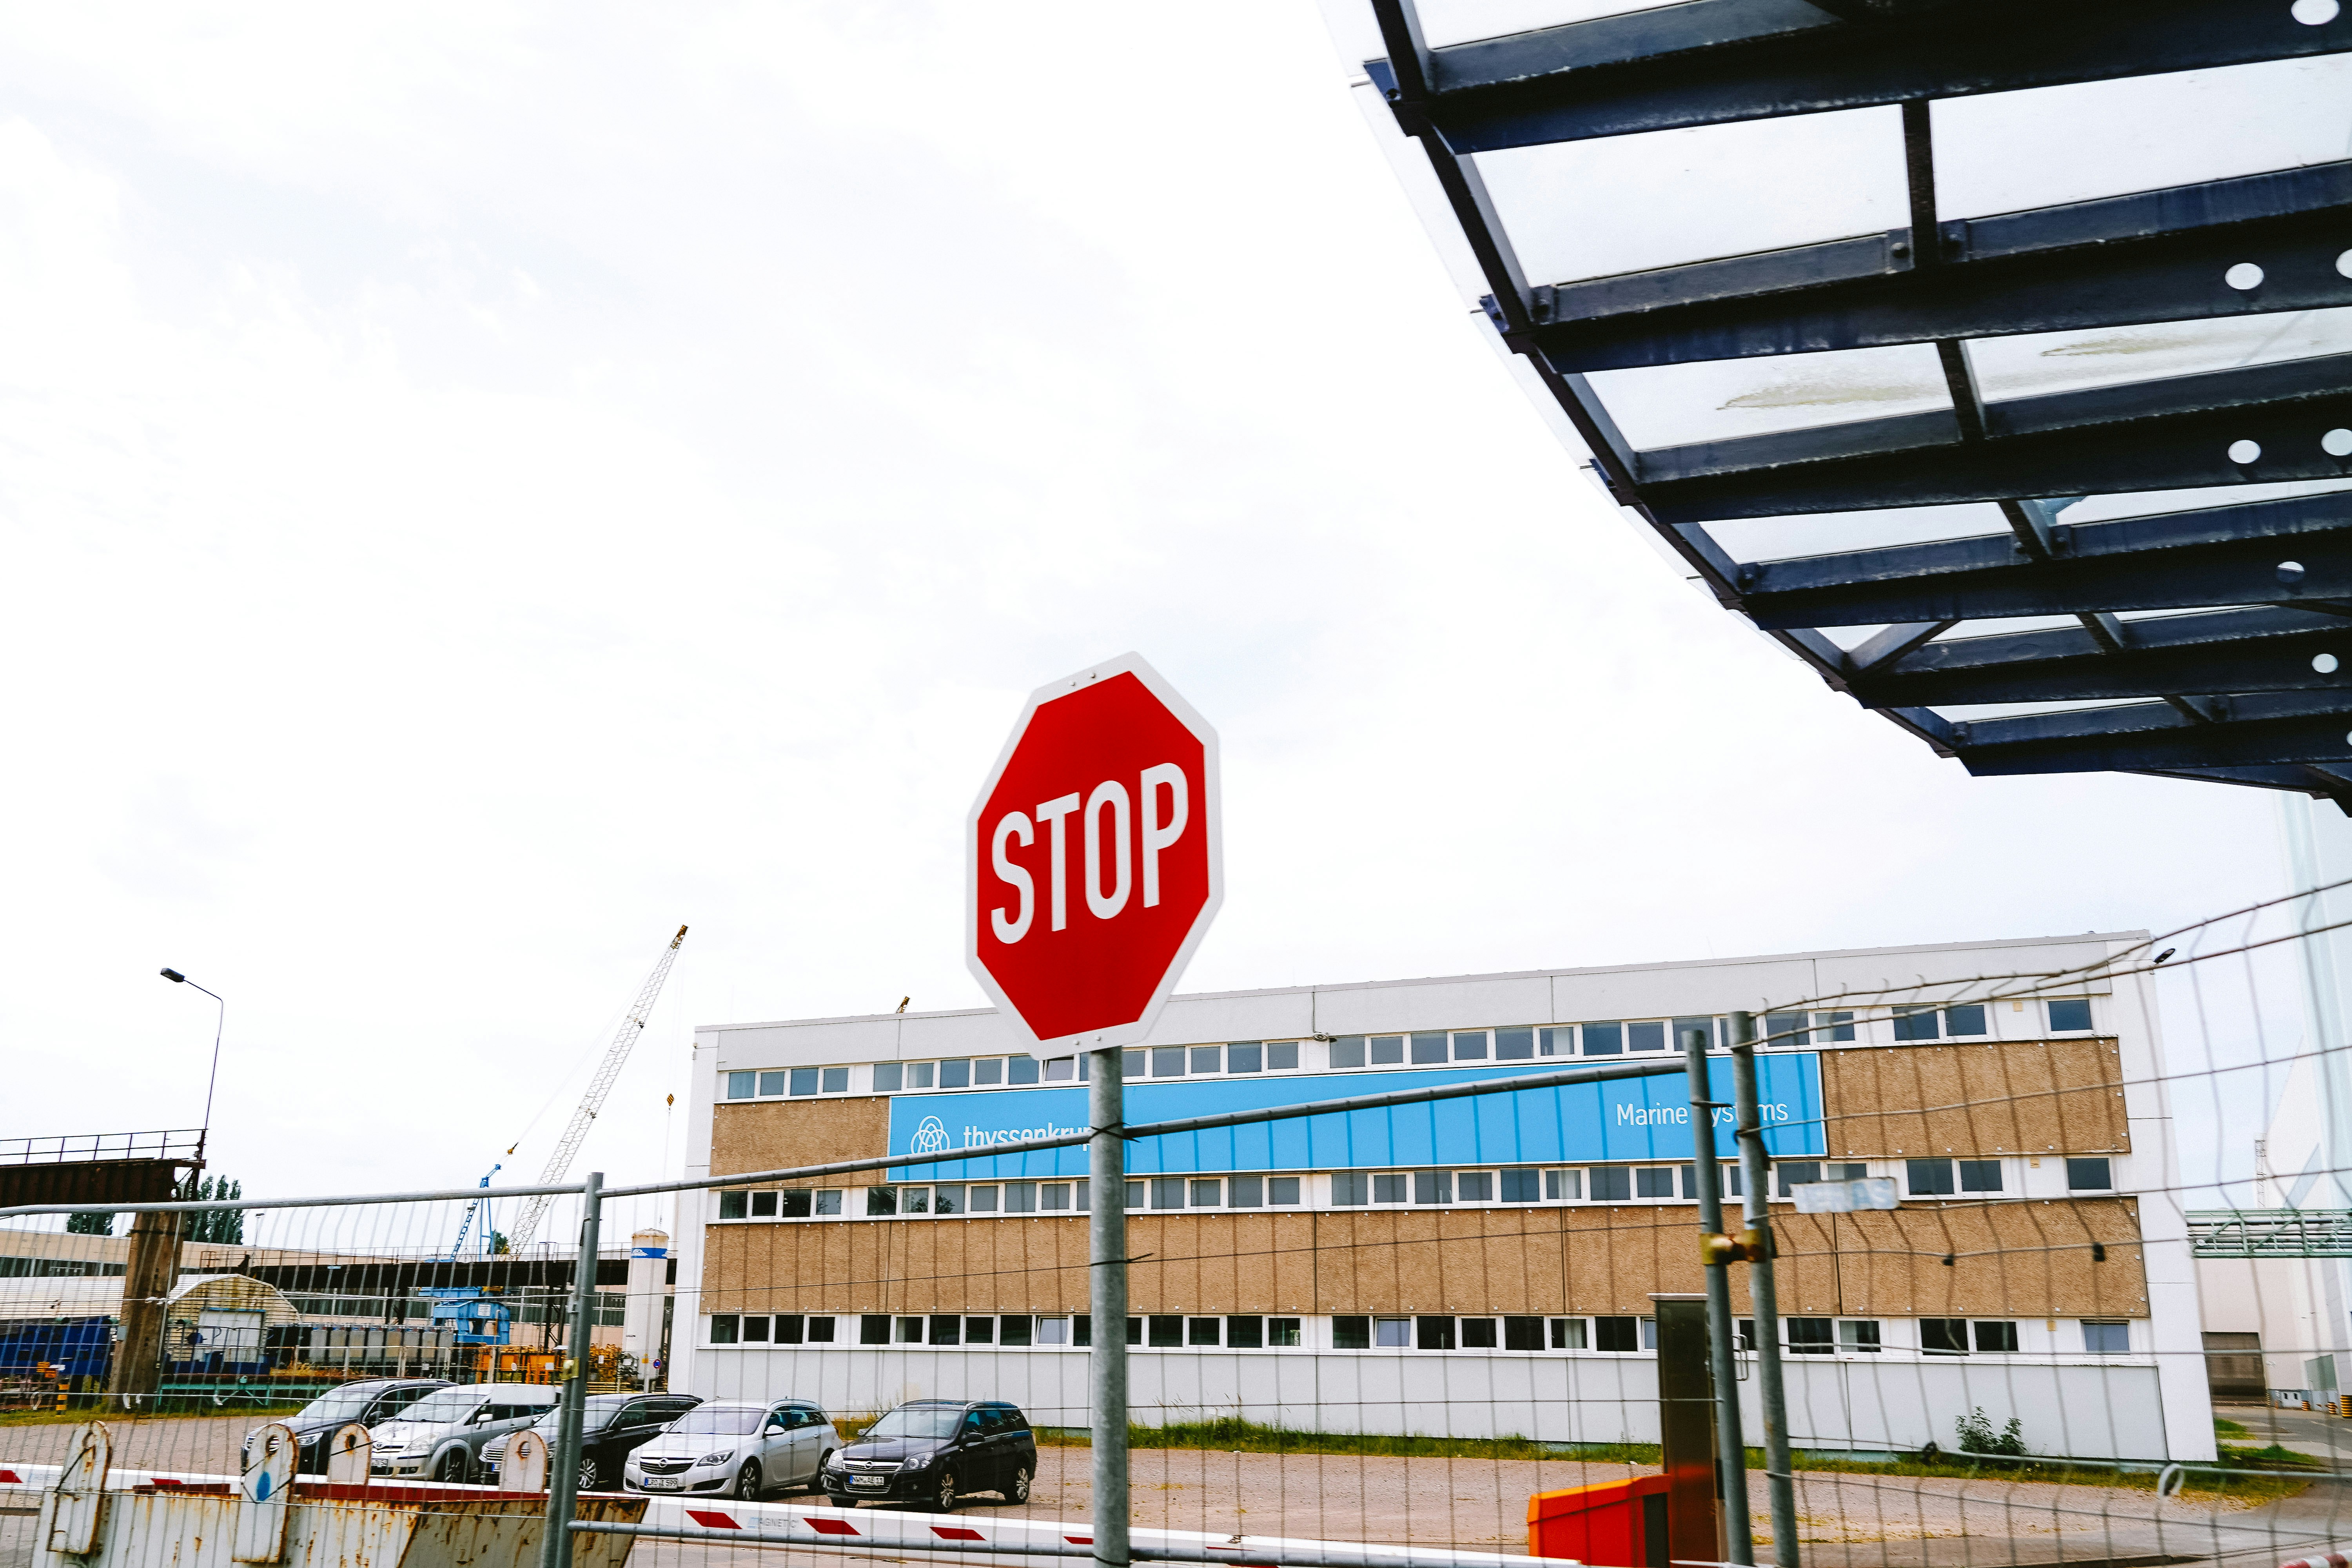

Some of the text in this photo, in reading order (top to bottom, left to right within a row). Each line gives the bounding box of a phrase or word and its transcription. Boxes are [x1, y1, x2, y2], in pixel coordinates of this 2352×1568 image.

[991, 762, 1189, 944] STOP
[1617, 1102, 1788, 1127] Marine ysms
